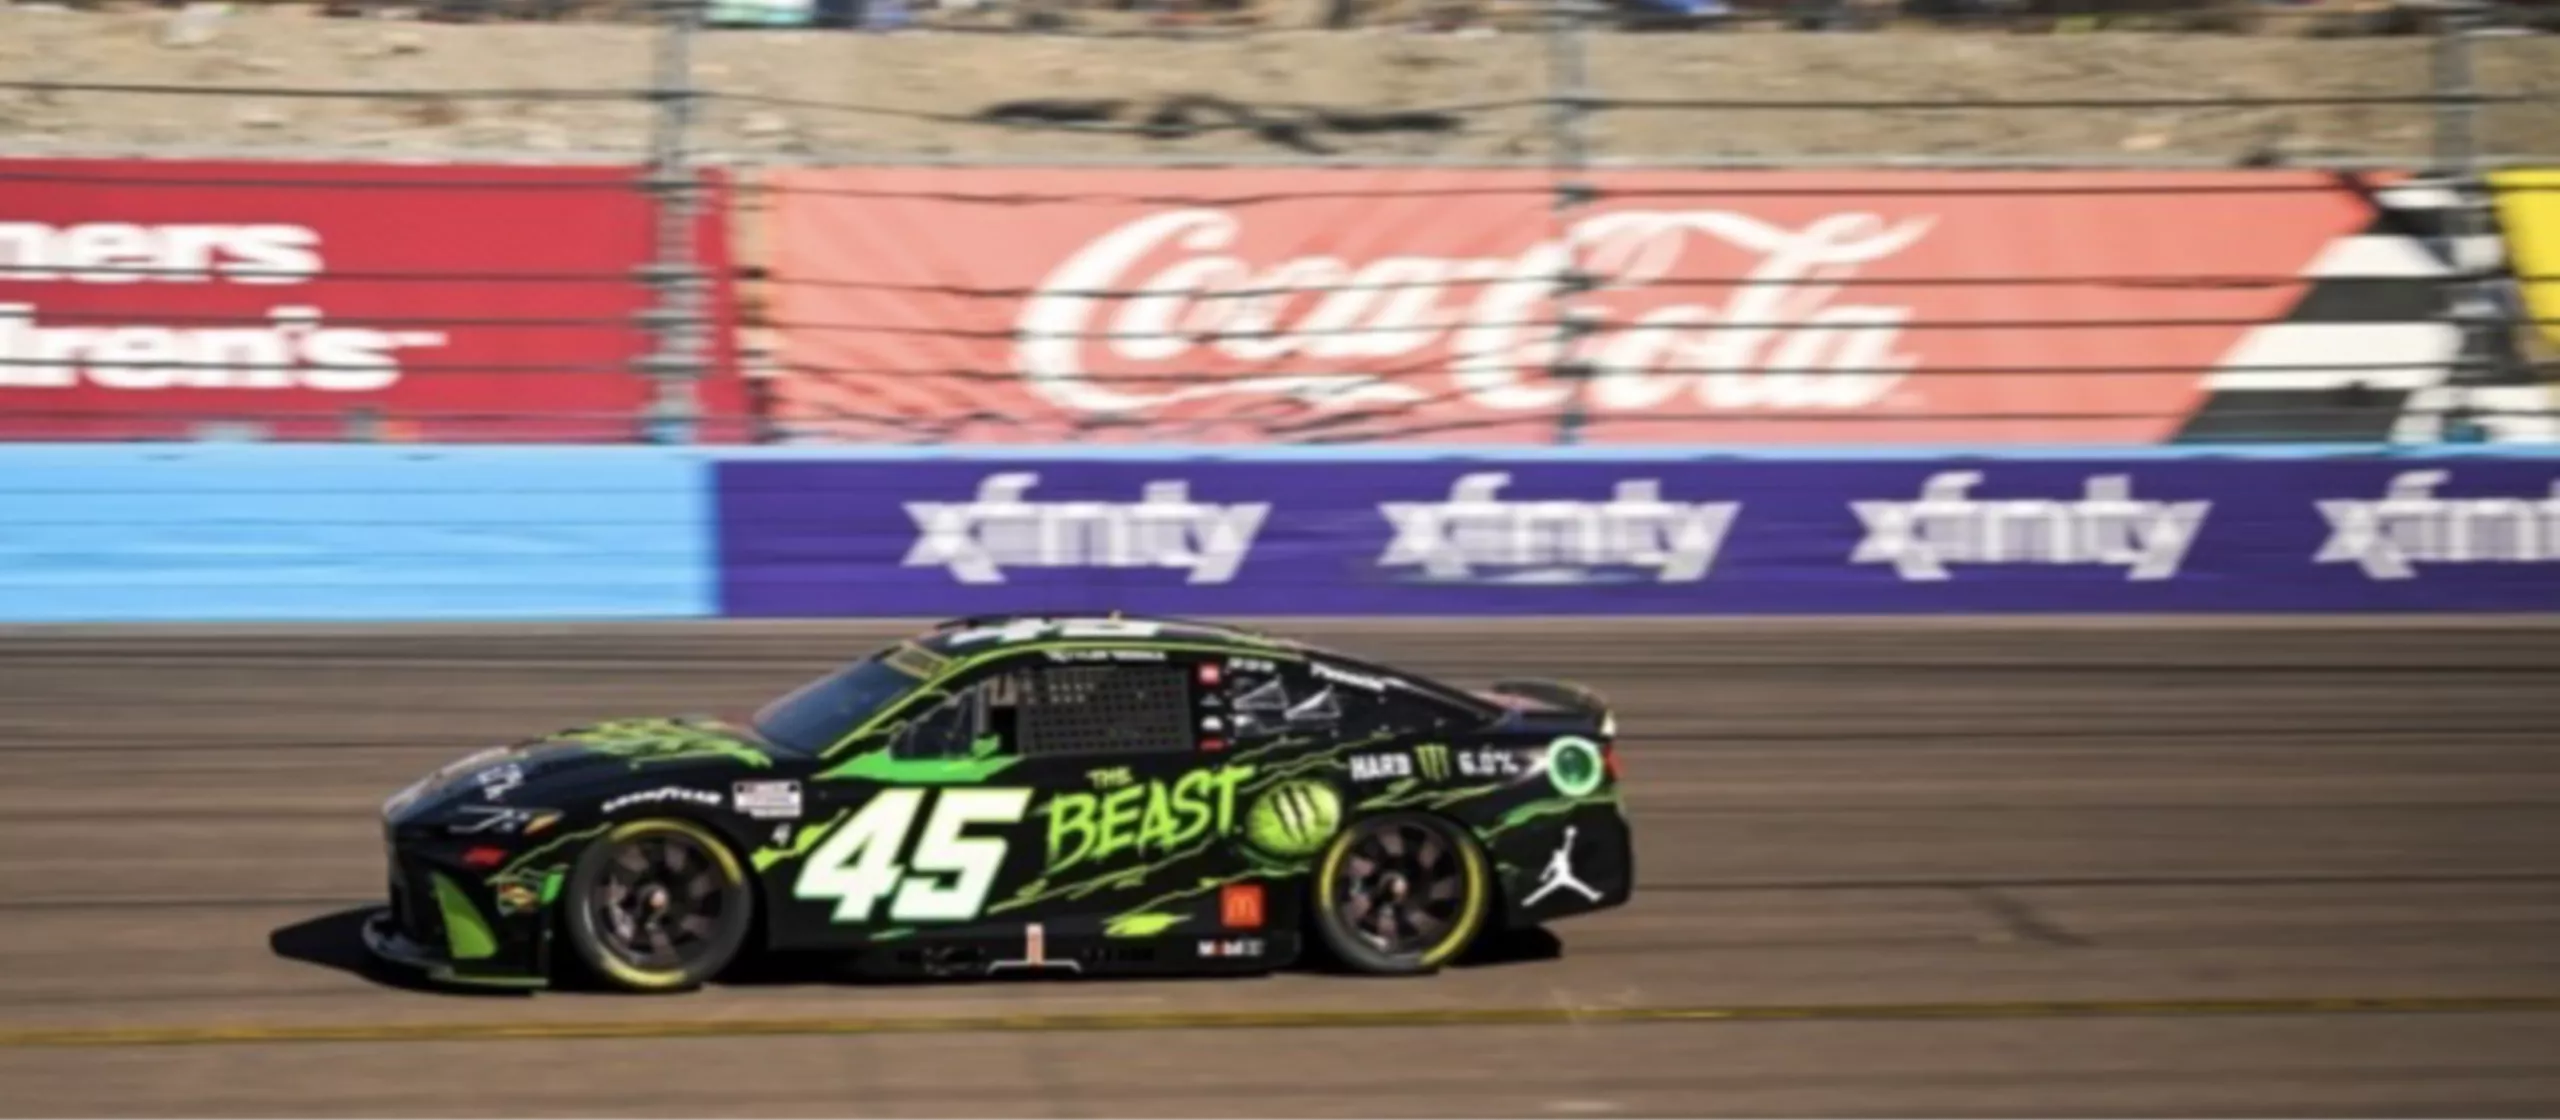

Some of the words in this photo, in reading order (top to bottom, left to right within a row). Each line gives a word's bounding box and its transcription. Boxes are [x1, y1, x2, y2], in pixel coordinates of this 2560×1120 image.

[902, 473, 1271, 583] xfinity
[1377, 473, 1742, 583] xfinity
[1847, 472, 2213, 580] xfinity
[1048, 765, 1254, 874] BEAST
[1350, 754, 1411, 780] HARD
[794, 787, 1033, 922] 45
